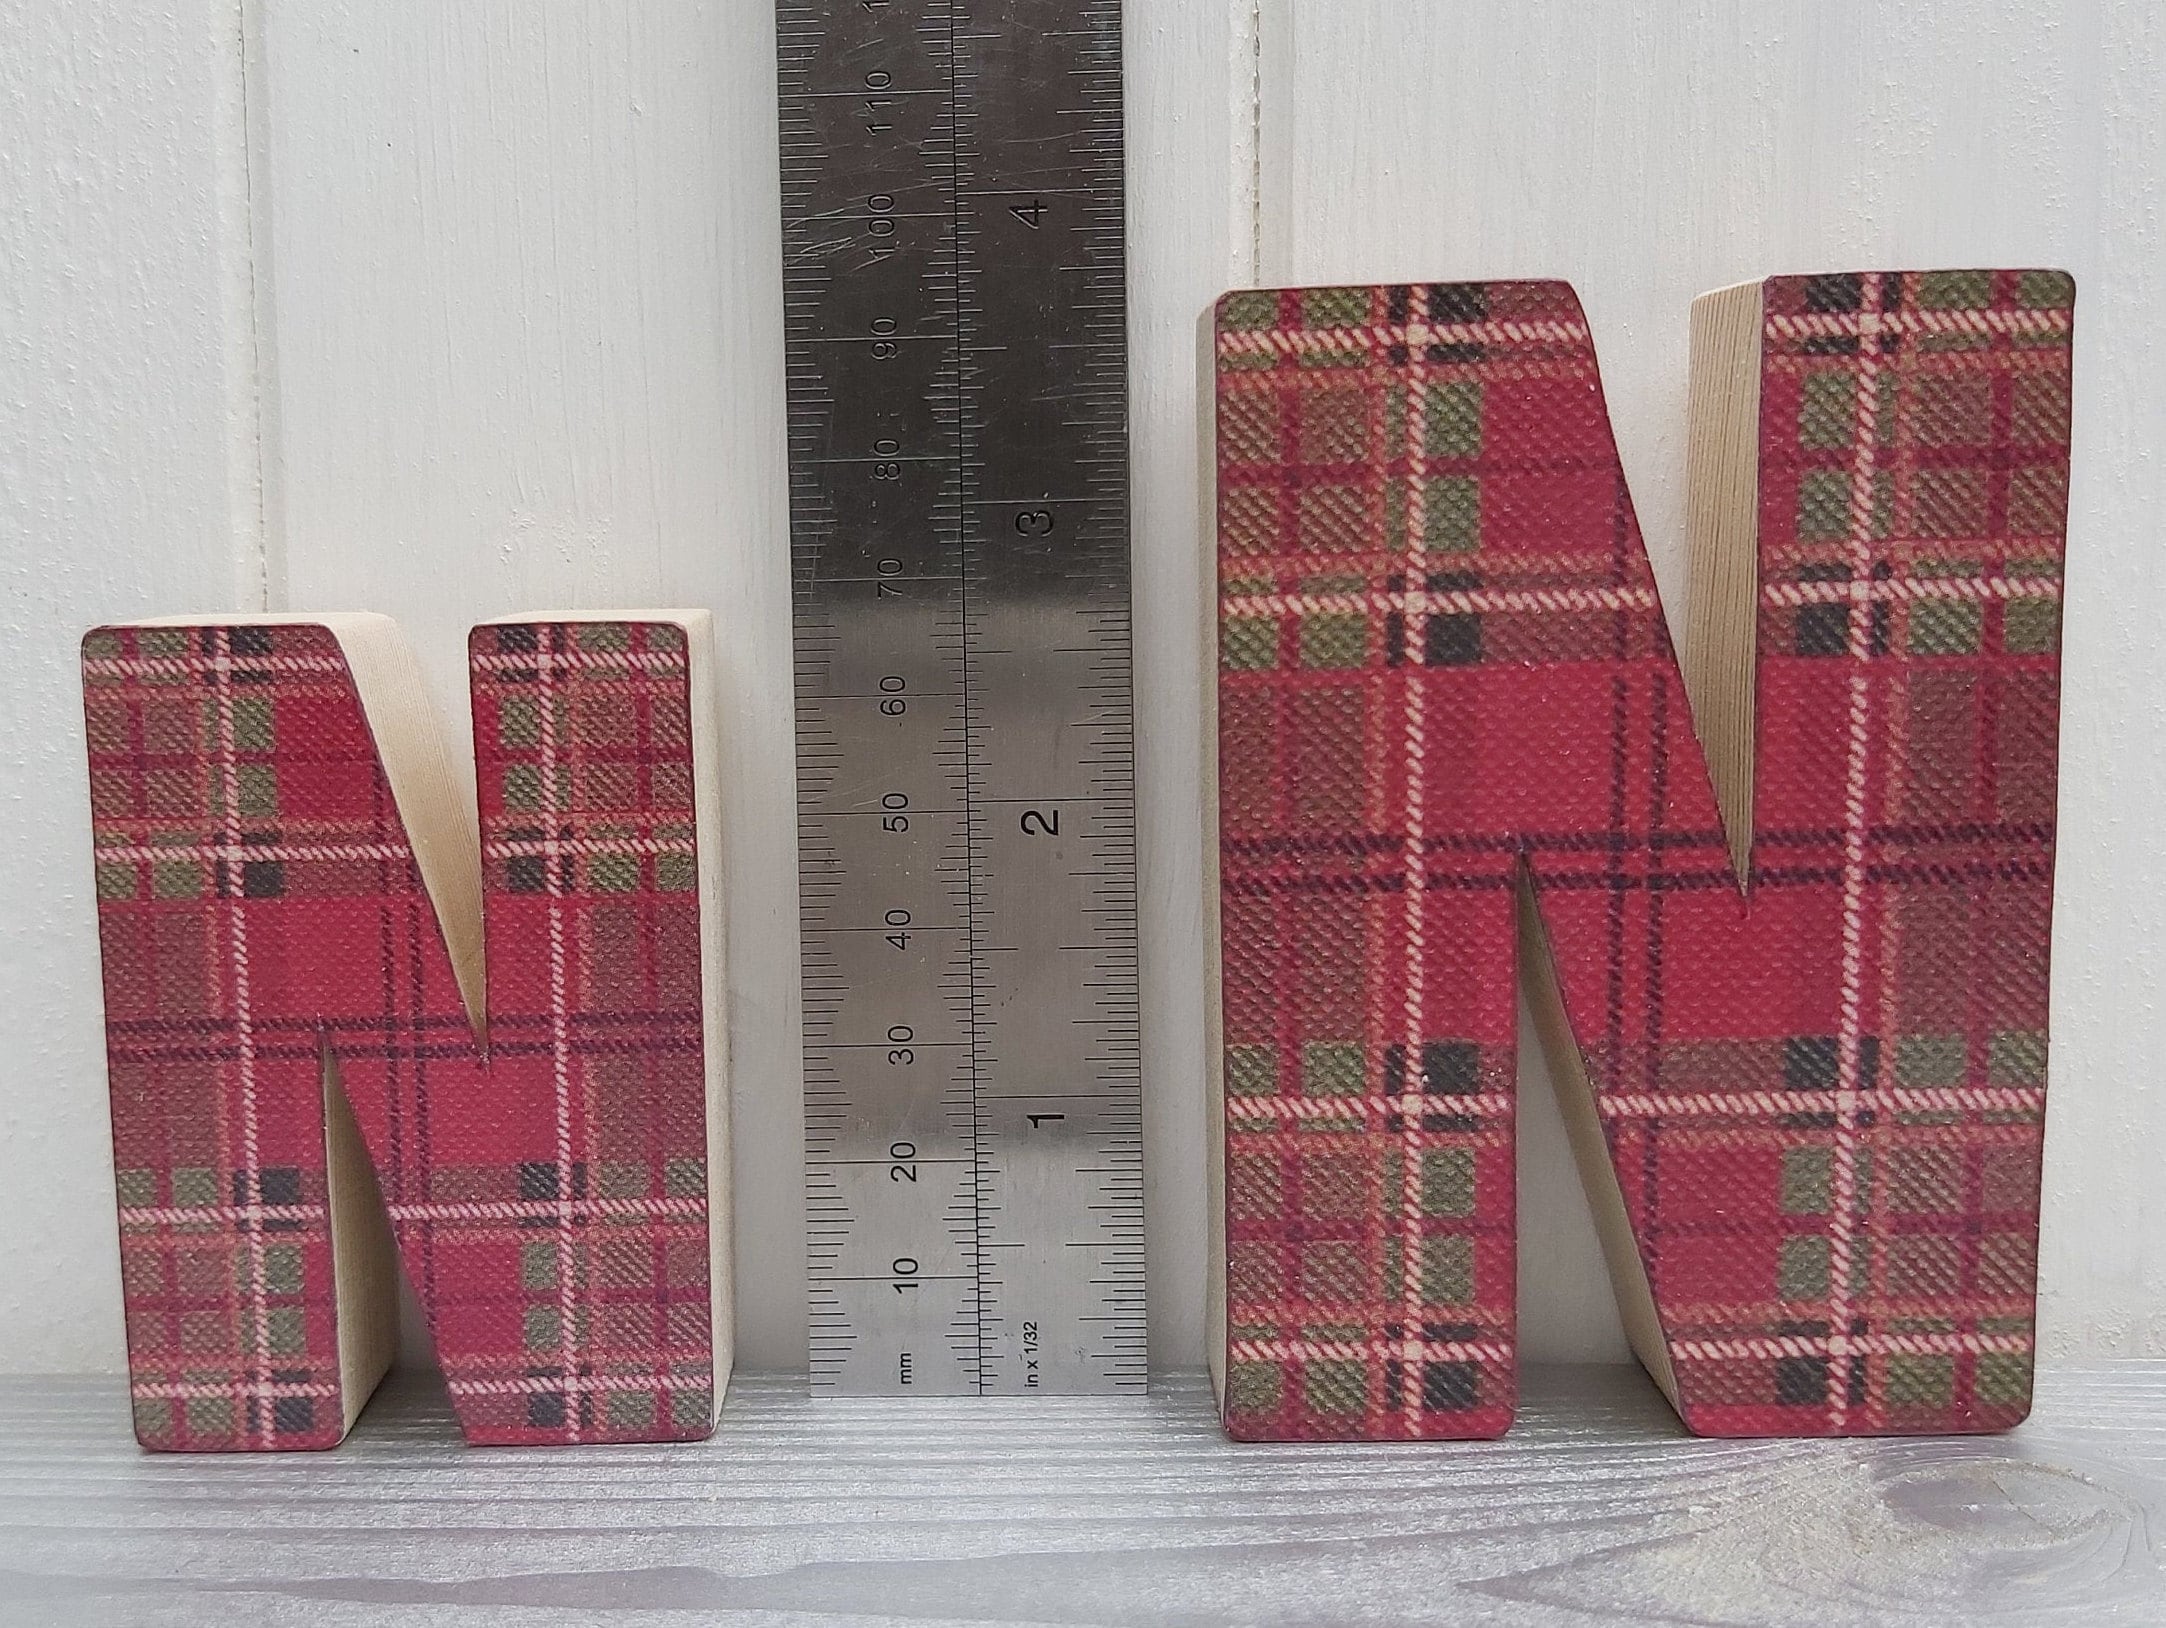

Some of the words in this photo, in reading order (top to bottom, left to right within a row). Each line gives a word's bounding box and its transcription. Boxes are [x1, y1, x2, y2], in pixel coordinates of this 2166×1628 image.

[865, 70, 892, 136] 110
[867, 194, 895, 260] 100
[1008, 199, 1049, 230] 4
[870, 317, 897, 361] 90
[873, 438, 901, 482] 80
[1014, 509, 1054, 538] 3
[877, 558, 903, 600] 70
[879, 675, 906, 717] 60
[882, 792, 909, 833] 50
[1019, 809, 1059, 836] 2
[885, 909, 911, 951] 40
[887, 1025, 914, 1065] 30
[1026, 1113, 1065, 1129] 1
[890, 1142, 917, 1183] 20
[892, 1257, 919, 1294] 10
[1023, 1321, 1039, 1355] 1/32
[899, 1352, 912, 1385] mm
[1024, 1371, 1039, 1388] in
[1027, 1358, 1039, 1370] x
